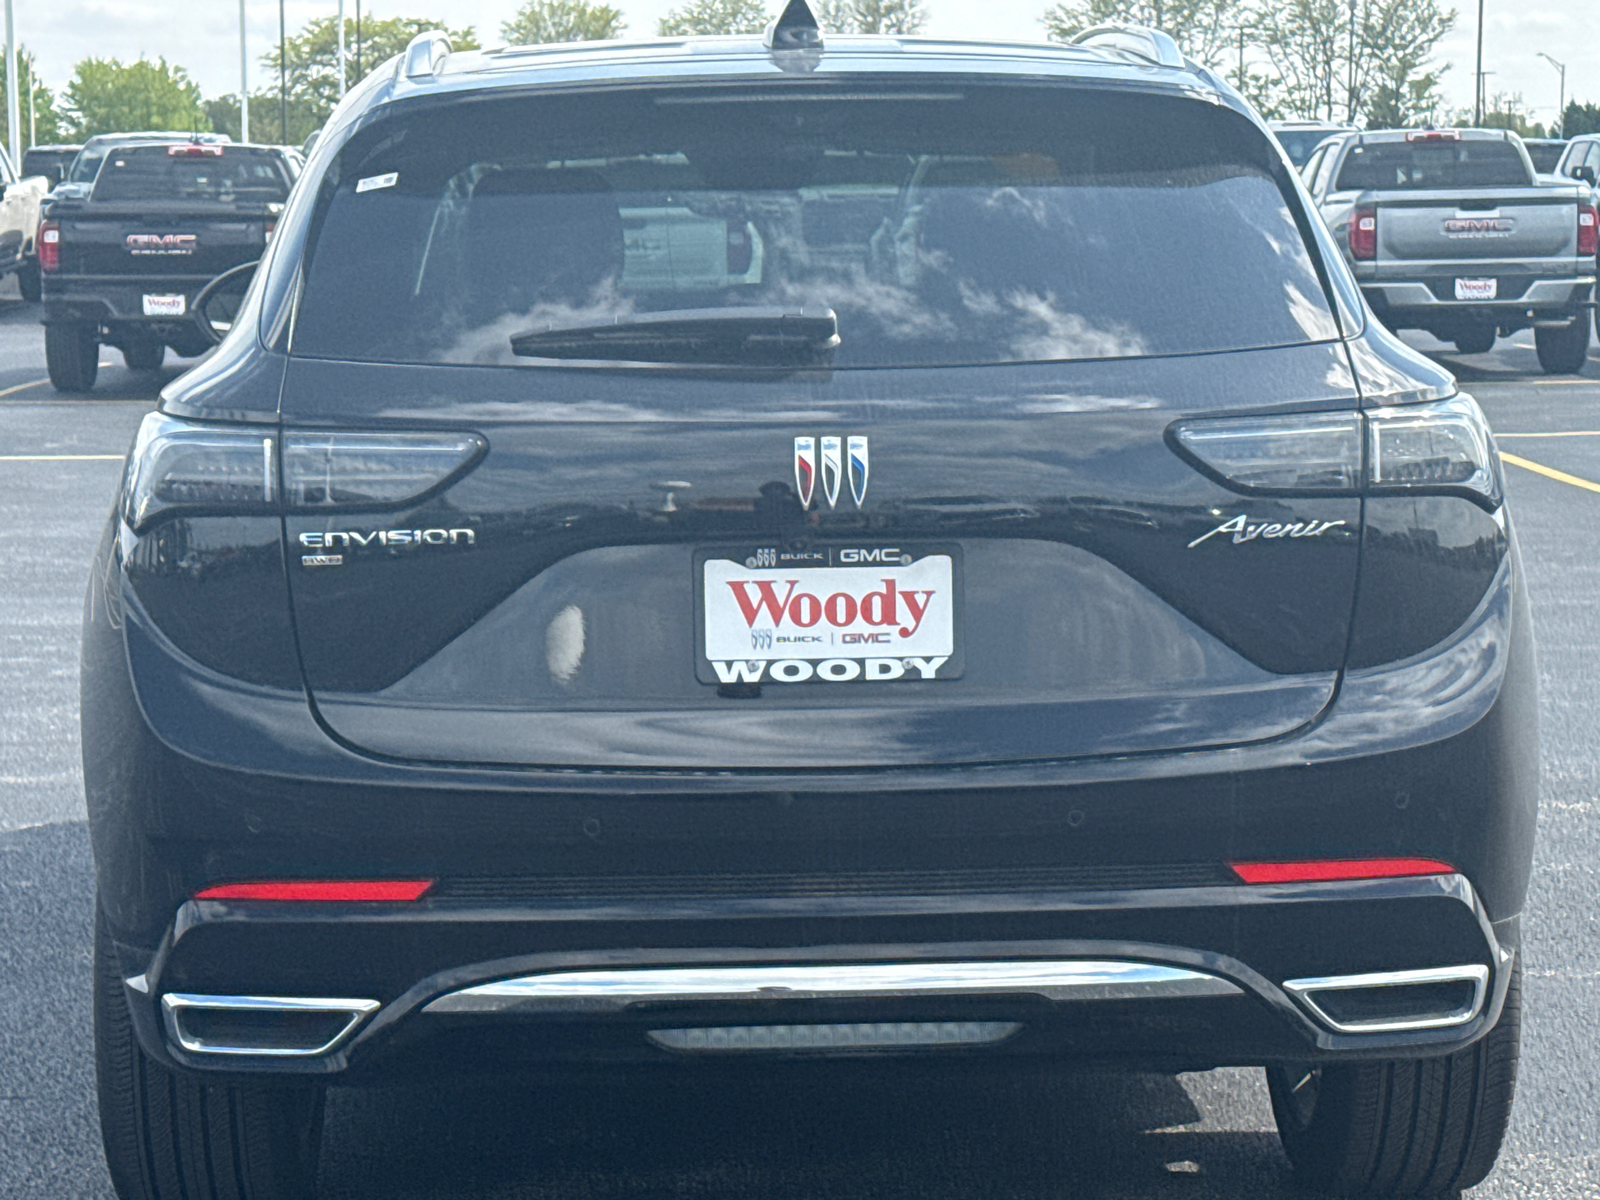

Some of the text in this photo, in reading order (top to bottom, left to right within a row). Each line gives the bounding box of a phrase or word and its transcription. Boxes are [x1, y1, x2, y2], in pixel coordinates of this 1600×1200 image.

[1444, 218, 1513, 232] GMC
[126, 234, 197, 248] GMC
[1458, 281, 1493, 293] Woody
[147, 298, 181, 308] Woody
[1187, 514, 1346, 548] Avenir
[780, 548, 901, 562] BUICK GMC
[726, 579, 936, 638] Woody
[776, 632, 891, 644] BUICK GMC
[711, 656, 949, 683] WOODY
